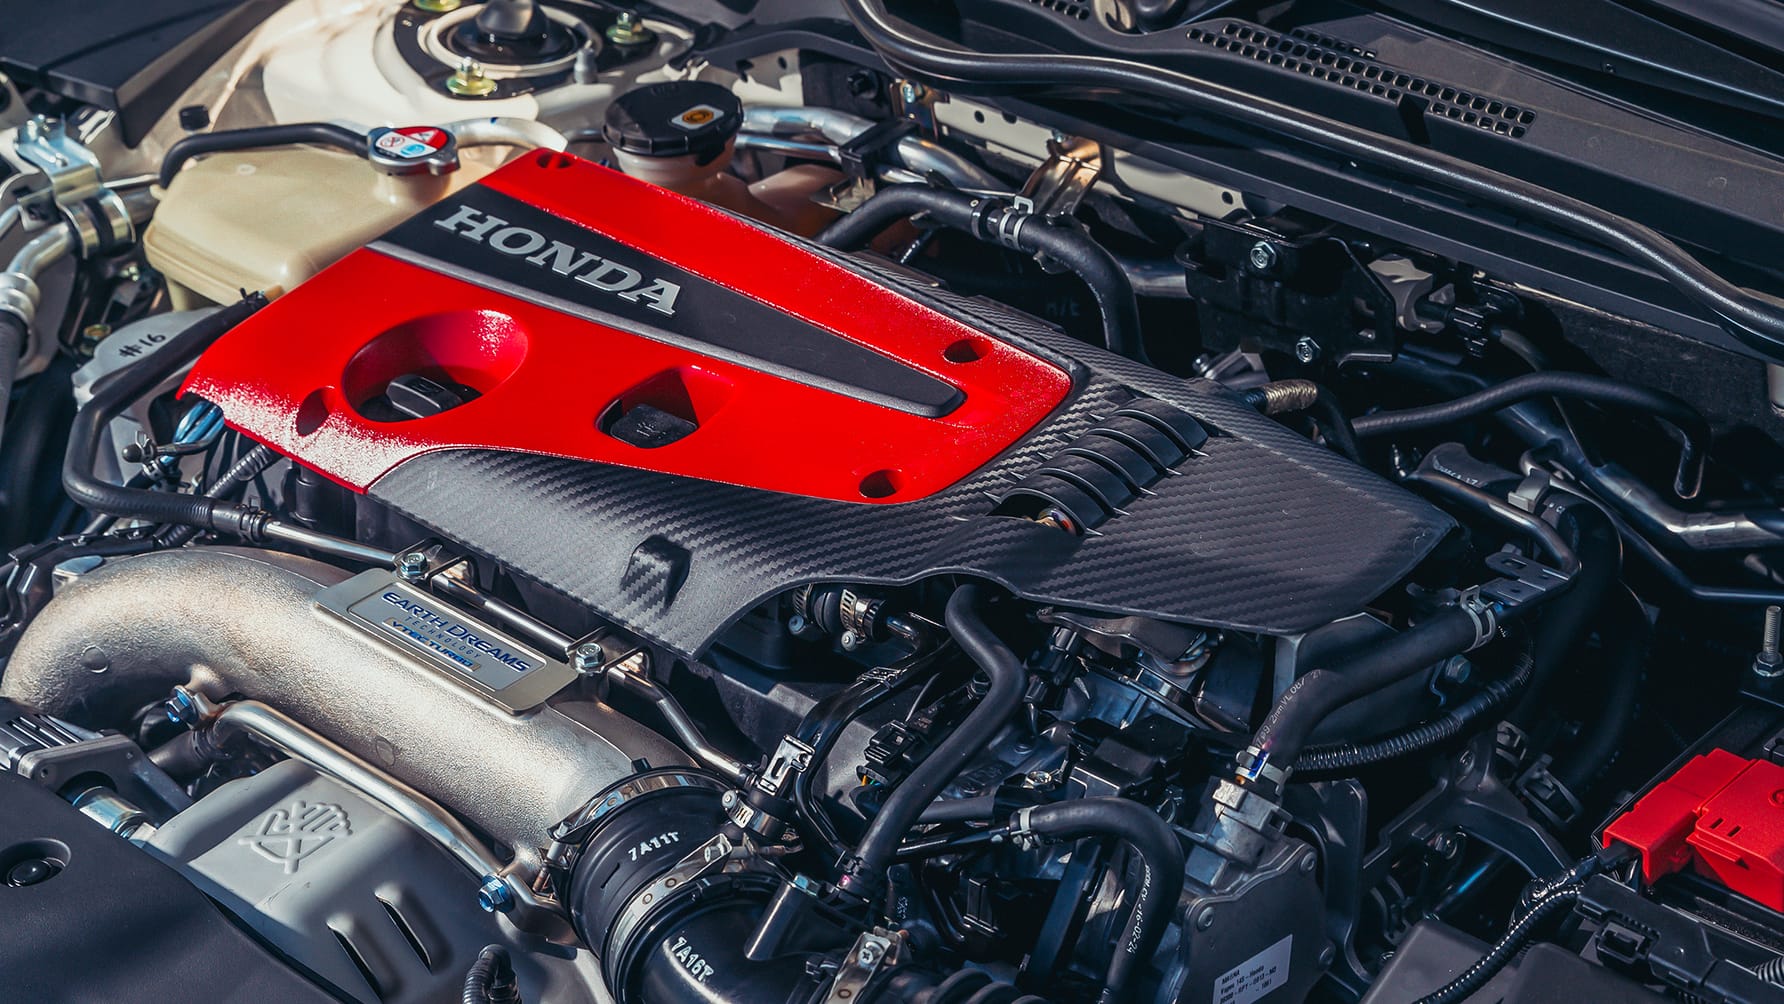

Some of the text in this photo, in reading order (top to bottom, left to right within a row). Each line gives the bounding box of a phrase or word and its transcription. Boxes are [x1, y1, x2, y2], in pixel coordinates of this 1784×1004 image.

[434, 204, 681, 316] HONDA
[119, 334, 166, 357] #16
[381, 592, 532, 673] EARTH DREAMS
[391, 621, 474, 667] VTEC TURBO
[404, 616, 482, 659] TECHNOLOGY
[628, 831, 680, 862] 7A11T
[671, 936, 715, 982] 7A16T
